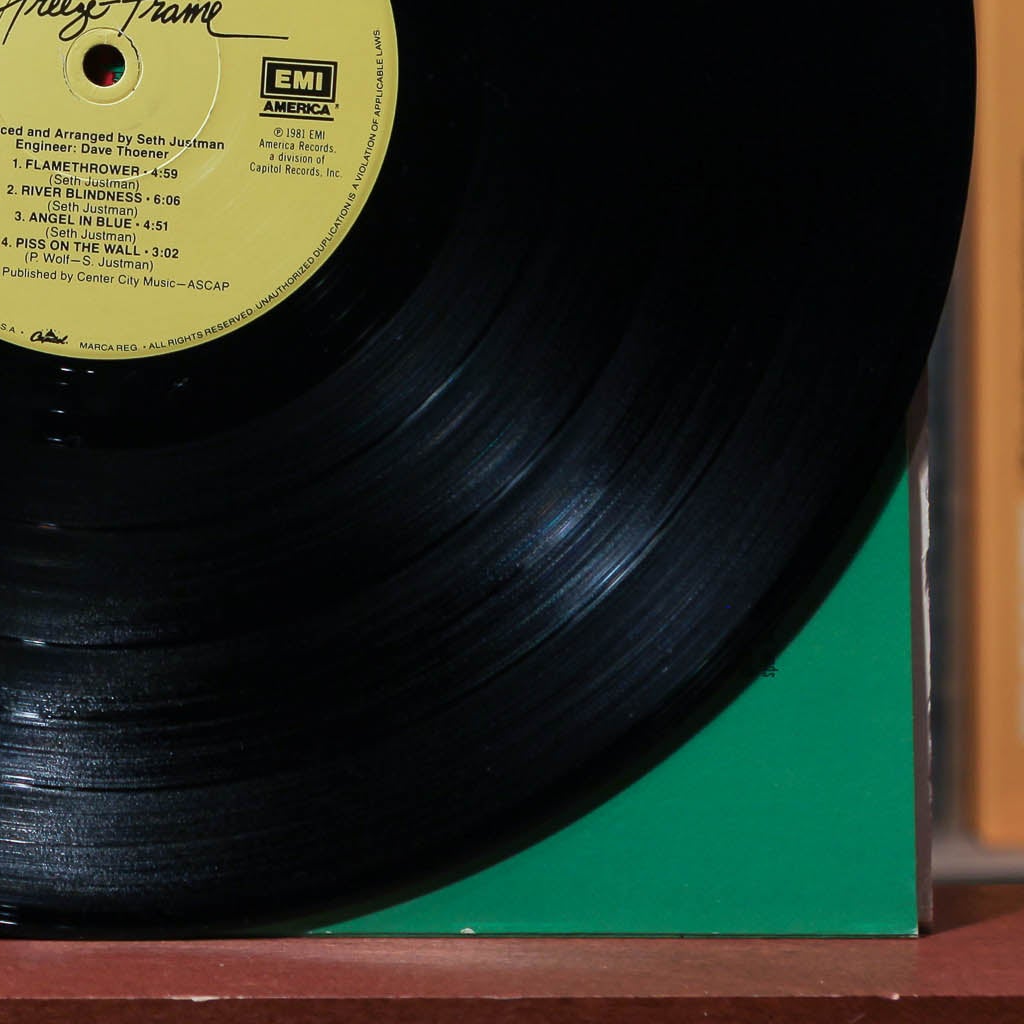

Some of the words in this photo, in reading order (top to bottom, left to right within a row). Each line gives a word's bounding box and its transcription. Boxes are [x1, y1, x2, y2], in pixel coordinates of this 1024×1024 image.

[275, 69, 323, 91] EMI
[374, 60, 384, 117] APPLICABLE
[264, 101, 330, 115] AMERICA
[371, 118, 379, 132] OF
[27, 128, 50, 138] and
[55, 129, 113, 143] Arranged
[117, 132, 133, 145] by
[137, 134, 165, 146] Seth
[169, 137, 224, 150] Justman
[286, 129, 305, 138] 1981
[310, 130, 325, 140] EMI
[15, 139, 77, 153] Engineer:
[81, 144, 112, 155] Dave
[116, 147, 169, 159] Thoener
[259, 139, 294, 150] America
[278, 152, 312, 164] division
[316, 155, 325, 164] of
[356, 134, 376, 181] VIOLATION
[12, 159, 21, 169] 1.
[25, 159, 139, 176] FLAMETHROWER
[151, 169, 178, 179] 4:59
[250, 162, 281, 174] Capitol
[327, 168, 342, 178] Inc.
[49, 174, 81, 186] (Seth
[85, 177, 140, 192] Justman)
[7, 184, 17, 195] 2.
[21, 185, 62, 198] RIVER
[66, 188, 142, 203] BLINDNESS
[153, 194, 180, 205] 6:06
[348, 192, 356, 202] IS
[48, 200, 79, 212] (Seth
[82, 203, 138, 217] Justman)
[15, 211, 25, 221] 3.
[29, 212, 75, 226] ANGEL
[79, 216, 92, 226] IN
[97, 217, 132, 228] BLUE
[143, 220, 168, 231] 4:51
[313, 203, 351, 257] DUPLICATION
[45, 227, 77, 239] (Seth
[81, 230, 136, 243] Justman)
[1, 237, 12, 248] 4.
[16, 238, 46, 250] PISS
[50, 240, 69, 251] ON
[73, 241, 100, 253] THE
[104, 243, 140, 256] WALL
[152, 247, 179, 258] 3:02
[25, 253, 39, 264] (P.
[98, 257, 154, 271] Justman)
[2, 267, 56, 280] Published
[60, 271, 73, 282] by
[77, 272, 114, 284] Center
[118, 275, 139, 287] City
[255, 257, 315, 310] UNAUTHORIZED
[80, 342, 114, 351] MARCA
[149, 342, 166, 350] ALL
[168, 332, 204, 346] RIGHTS
